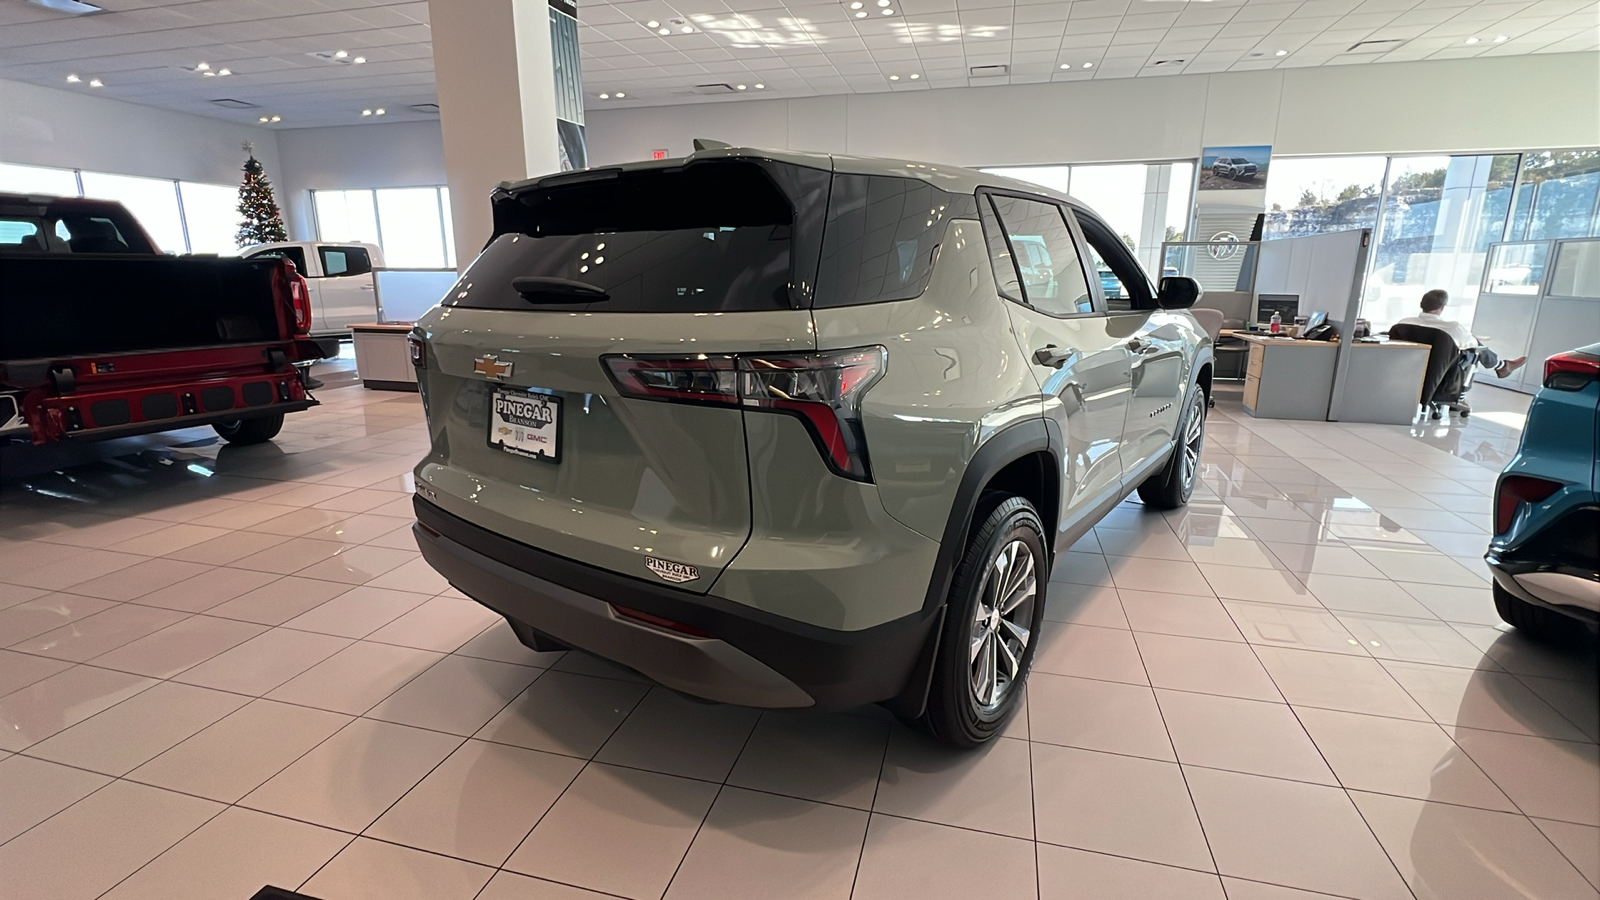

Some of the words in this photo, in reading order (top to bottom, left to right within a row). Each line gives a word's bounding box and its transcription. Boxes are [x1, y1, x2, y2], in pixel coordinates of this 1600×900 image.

[496, 399, 552, 422] PINEGAR
[509, 415, 537, 427] BRANSON
[527, 433, 548, 444] GMC
[646, 557, 698, 577] PINEGAR
